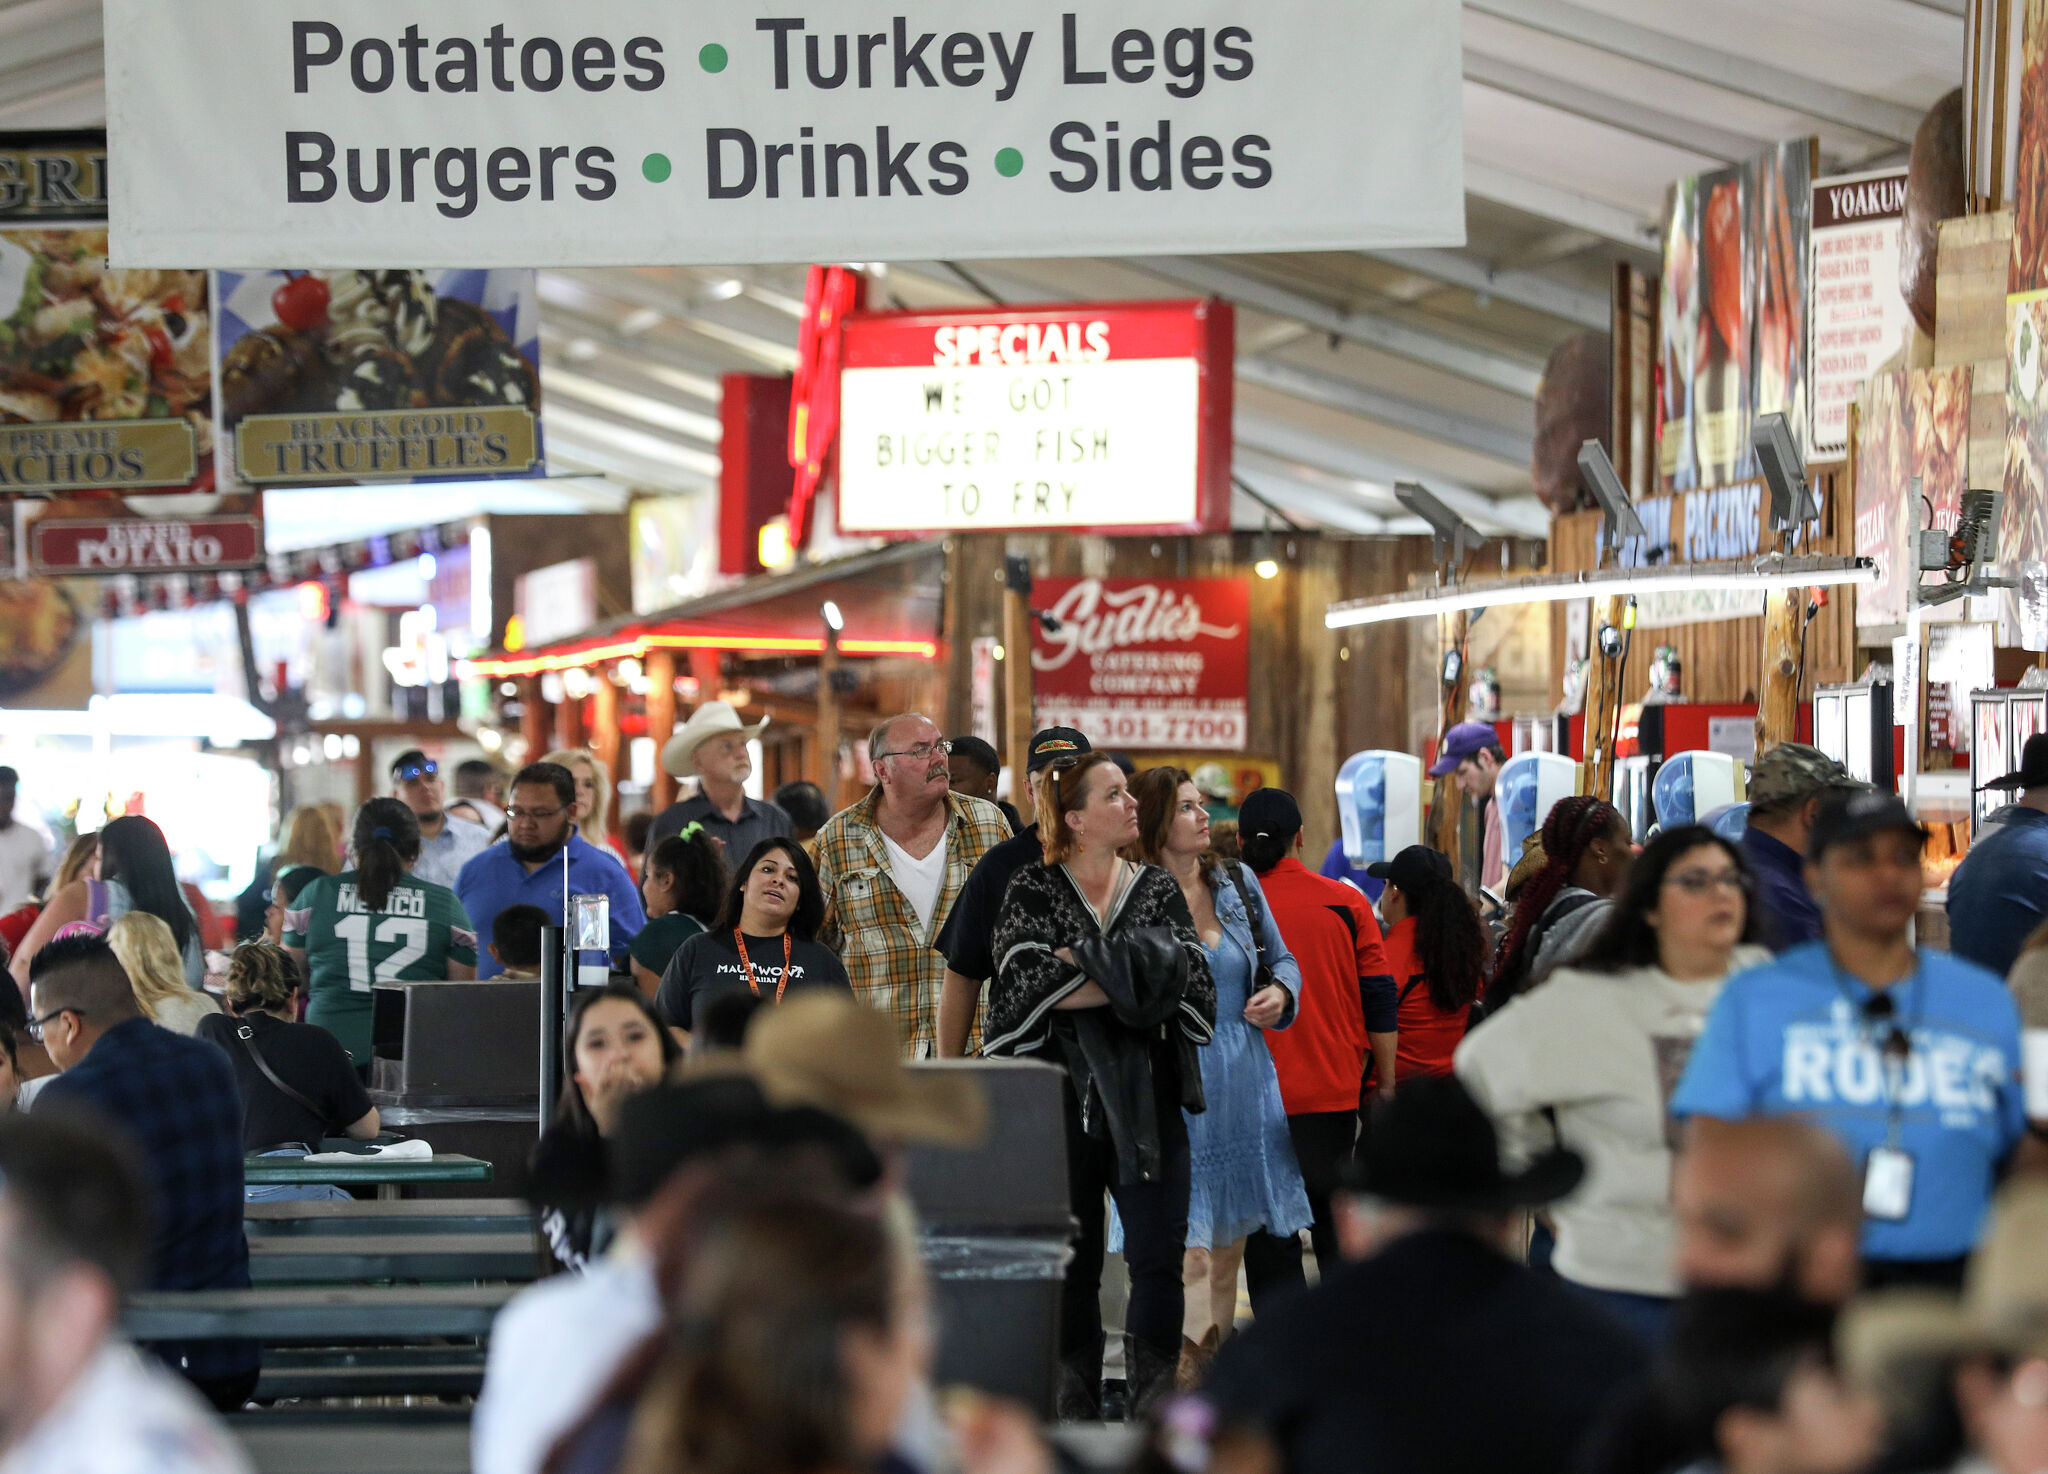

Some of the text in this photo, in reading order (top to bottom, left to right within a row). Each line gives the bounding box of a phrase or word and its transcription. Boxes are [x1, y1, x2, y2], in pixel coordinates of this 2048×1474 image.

[292, 14, 1255, 101] Potatoes Turkey Legs
[285, 120, 1273, 219] Burgers Drinks Sides
[933, 320, 1110, 367] SPECIALS
[923, 376, 1071, 414] WE GOT
[289, 413, 484, 441] BLACK GOLD
[265, 433, 508, 474] TRUFFLES
[877, 427, 1108, 467] BIGGER FISH
[943, 480, 1077, 516] TO FRY
[1683, 483, 1762, 562] PACKING
[78, 535, 223, 569] POTATO
[1089, 652, 1204, 672] CATERING
[1089, 673, 1199, 695] COMPANY
[336, 890, 426, 918] MEICO
[334, 914, 429, 993] 12
